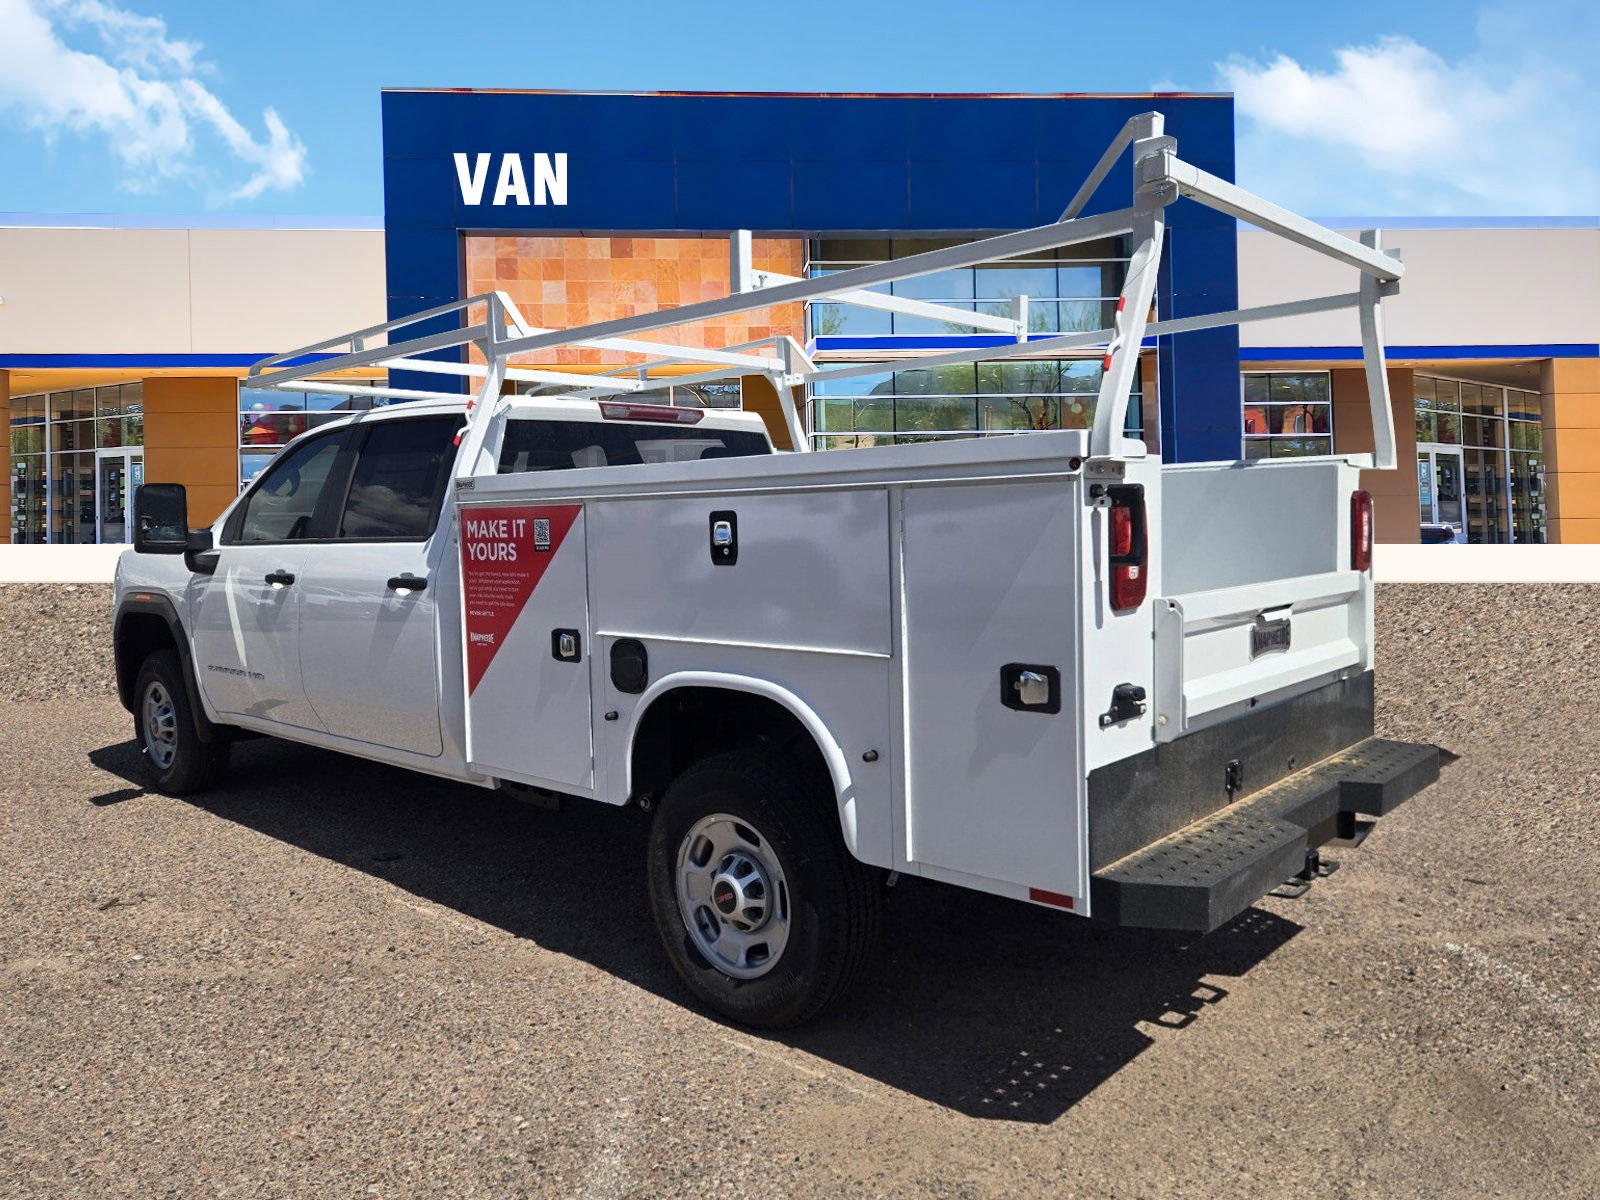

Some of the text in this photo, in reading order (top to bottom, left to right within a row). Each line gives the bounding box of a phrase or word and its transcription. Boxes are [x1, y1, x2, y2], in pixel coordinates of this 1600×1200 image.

[453, 152, 568, 206] VAN
[466, 519, 526, 538] MAKE IT
[467, 542, 517, 561] YOURS
